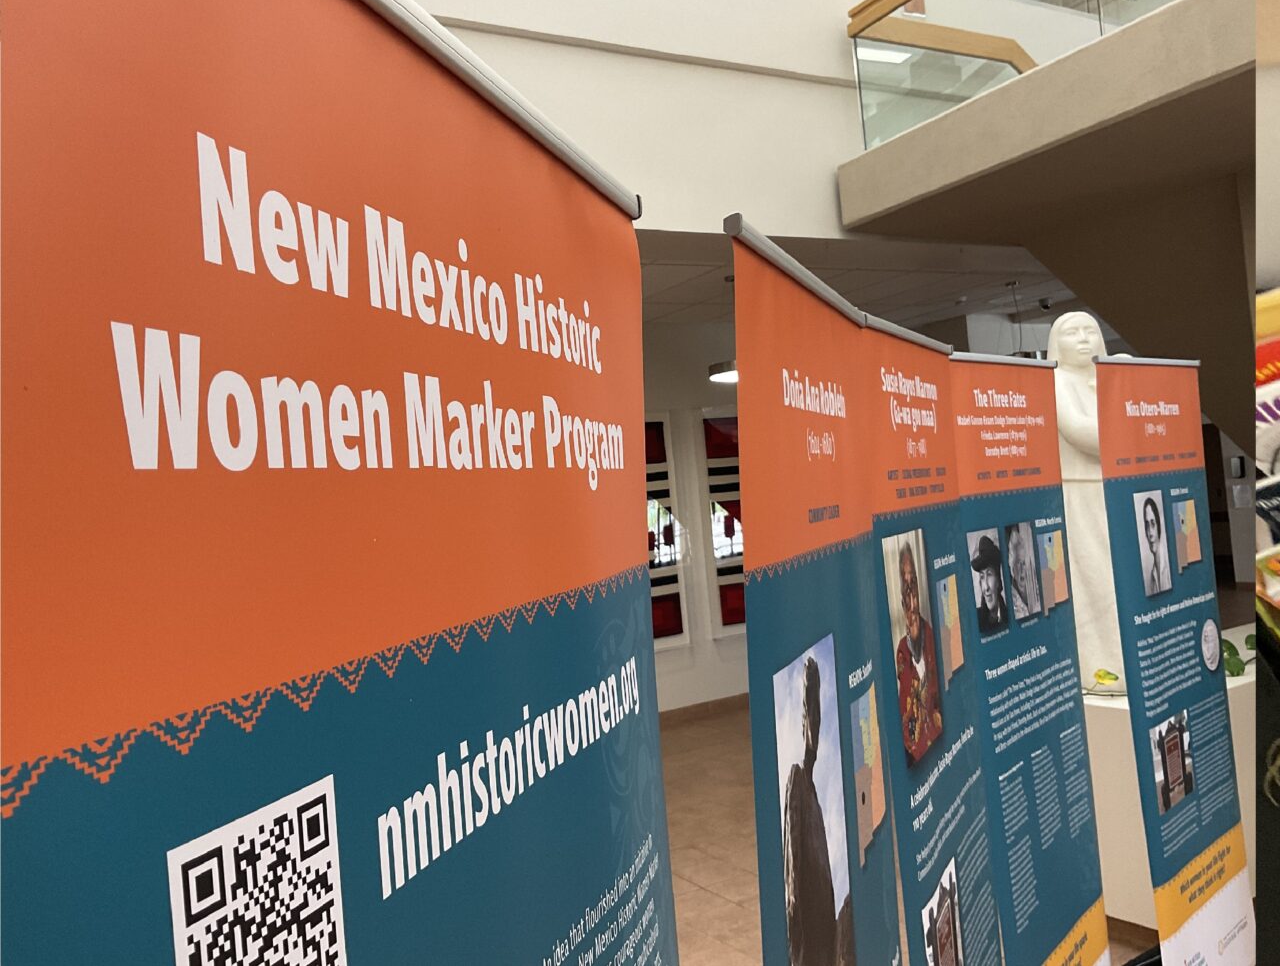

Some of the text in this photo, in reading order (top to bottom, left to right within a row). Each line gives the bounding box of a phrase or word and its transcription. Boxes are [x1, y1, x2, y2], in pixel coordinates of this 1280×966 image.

[196, 131, 602, 376] New Mexico Historic
[109, 320, 625, 492] Women Marker Program
[782, 367, 805, 411] Doña
[805, 376, 820, 414] Ana
[880, 366, 898, 394] Susie
[973, 388, 1027, 408] The Three Fates
[376, 655, 640, 899] nmhistoricwomen.org
[552, 939, 570, 966] idea
[569, 918, 585, 951] that
[585, 878, 619, 933] flourished
[578, 892, 638, 966] New Mexico Historic
